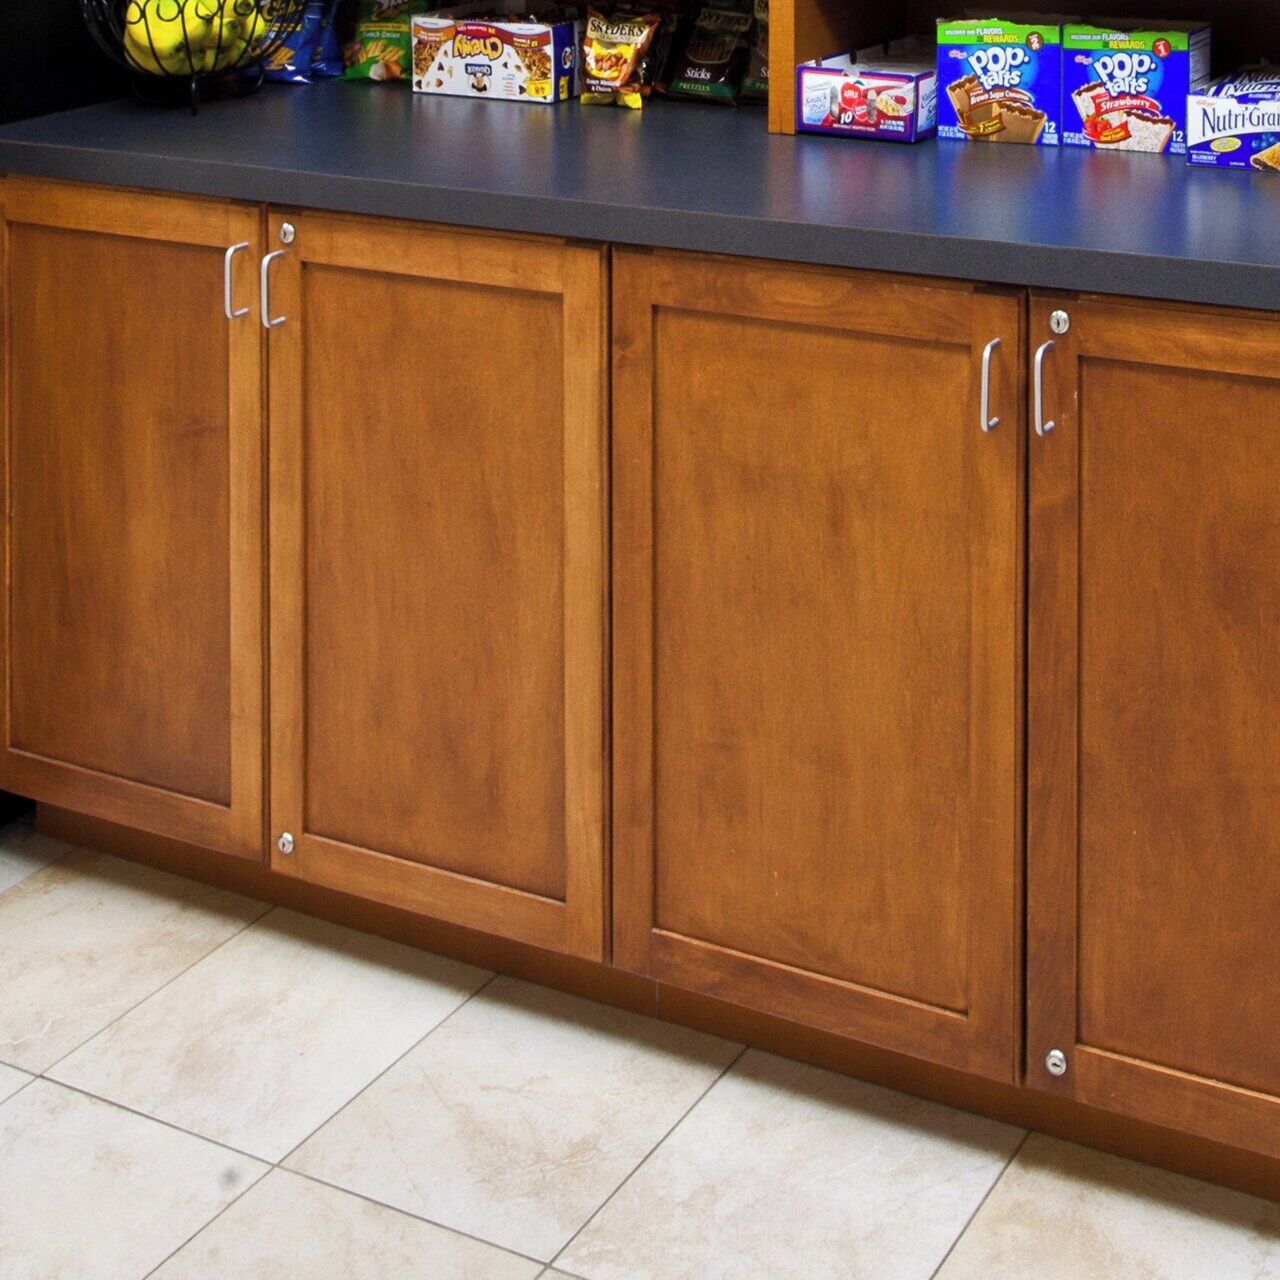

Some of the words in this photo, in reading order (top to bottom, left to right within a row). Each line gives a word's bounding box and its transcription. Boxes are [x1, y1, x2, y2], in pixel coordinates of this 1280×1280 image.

[976, 27, 1004, 36] FLAVORS
[983, 34, 1019, 43] REWARDS
[1109, 40, 1145, 49] REWARDS
[685, 67, 712, 80] Sticks
[679, 82, 711, 92] PRETZELS
[1101, 97, 1151, 112] Strawberry
[840, 111, 853, 124] 10
[1044, 121, 1056, 133] 12
